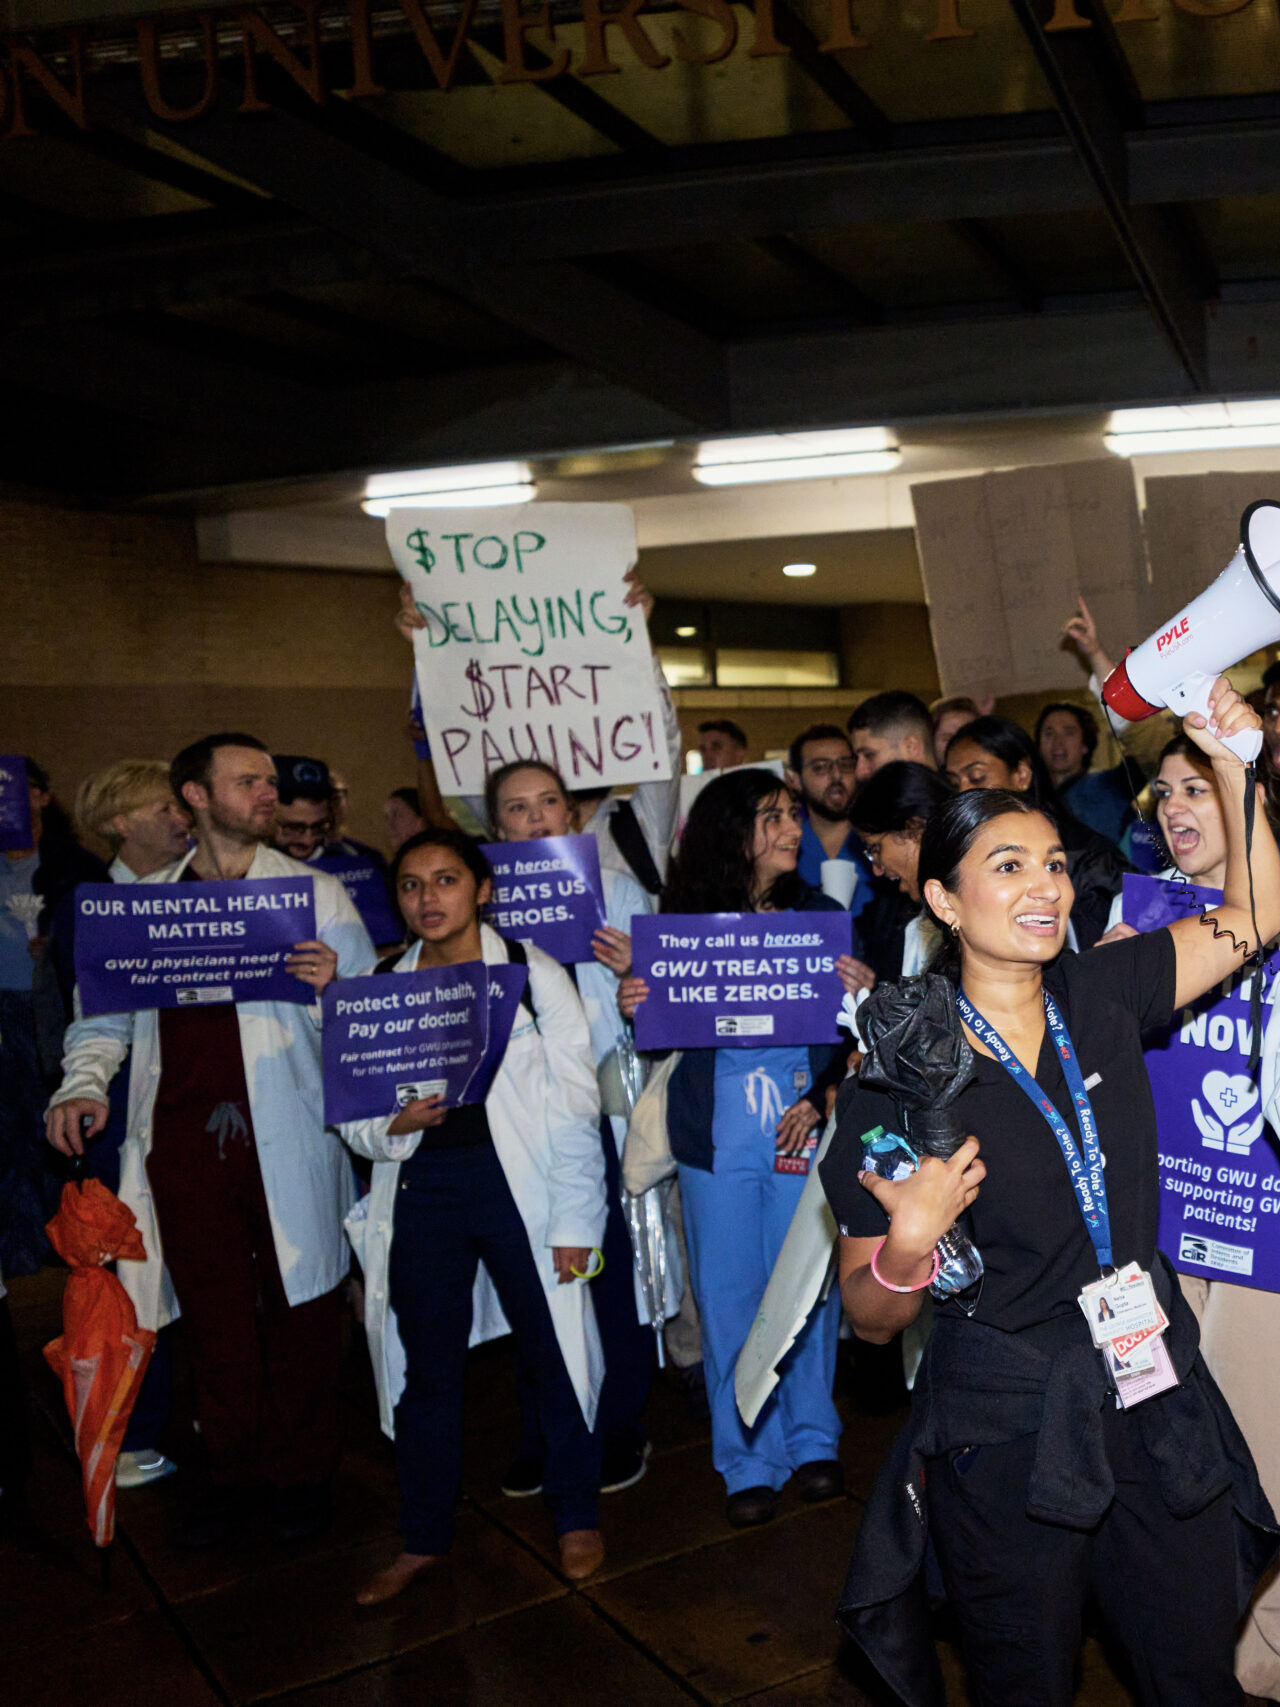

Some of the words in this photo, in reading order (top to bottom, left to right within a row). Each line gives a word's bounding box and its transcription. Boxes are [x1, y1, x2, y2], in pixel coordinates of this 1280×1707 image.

[406, 528, 546, 574] $TOP
[416, 589, 632, 656] DELAYING,
[1156, 617, 1190, 652] PYLE
[460, 658, 611, 722] $TART
[493, 865, 510, 876] us
[81, 899, 125, 915] OUR
[132, 898, 221, 915] MENTAL
[227, 892, 309, 912] HEALTH
[492, 883, 551, 903] EATS
[558, 879, 587, 897] US
[148, 921, 246, 939] MATTERS
[659, 934, 699, 950] They
[705, 934, 735, 947] call
[740, 936, 759, 947] us
[763, 932, 824, 948] heroes.
[105, 958, 148, 970] GWU
[151, 954, 236, 971] physicians
[240, 952, 280, 965] need
[131, 972, 159, 985] fair
[163, 970, 230, 983] contract
[234, 967, 274, 981] now!
[651, 961, 707, 978] GWU
[712, 958, 799, 976] TREATS
[806, 956, 835, 973] US
[336, 993, 400, 1016] Protect
[404, 991, 432, 1007] our
[435, 981, 476, 1004] health,
[668, 986, 717, 1002] LIKE
[724, 983, 819, 1002] ZEROES.
[348, 1022, 380, 1039] Pay
[384, 1018, 415, 1034] our
[418, 1007, 470, 1030] doctors!
[1046, 1002, 1063, 1030] Vote?
[974, 1020, 986, 1034] To
[984, 1030, 1011, 1061] Ready
[1180, 1009, 1264, 1057] NO
[340, 1053, 359, 1064] Fair
[360, 1047, 402, 1061] contract
[1080, 1109, 1097, 1145] Ready
[1056, 1129, 1075, 1160] Vote?
[1088, 1147, 1098, 1161] To
[1071, 1161, 1082, 1176] To
[1090, 1163, 1104, 1197] Vote?
[1158, 1153, 1212, 1182] porting
[1217, 1167, 1257, 1188] GWU
[1075, 1177, 1095, 1212] Ready
[1165, 1177, 1254, 1214] supporting
[1183, 1204, 1257, 1232] patients!
